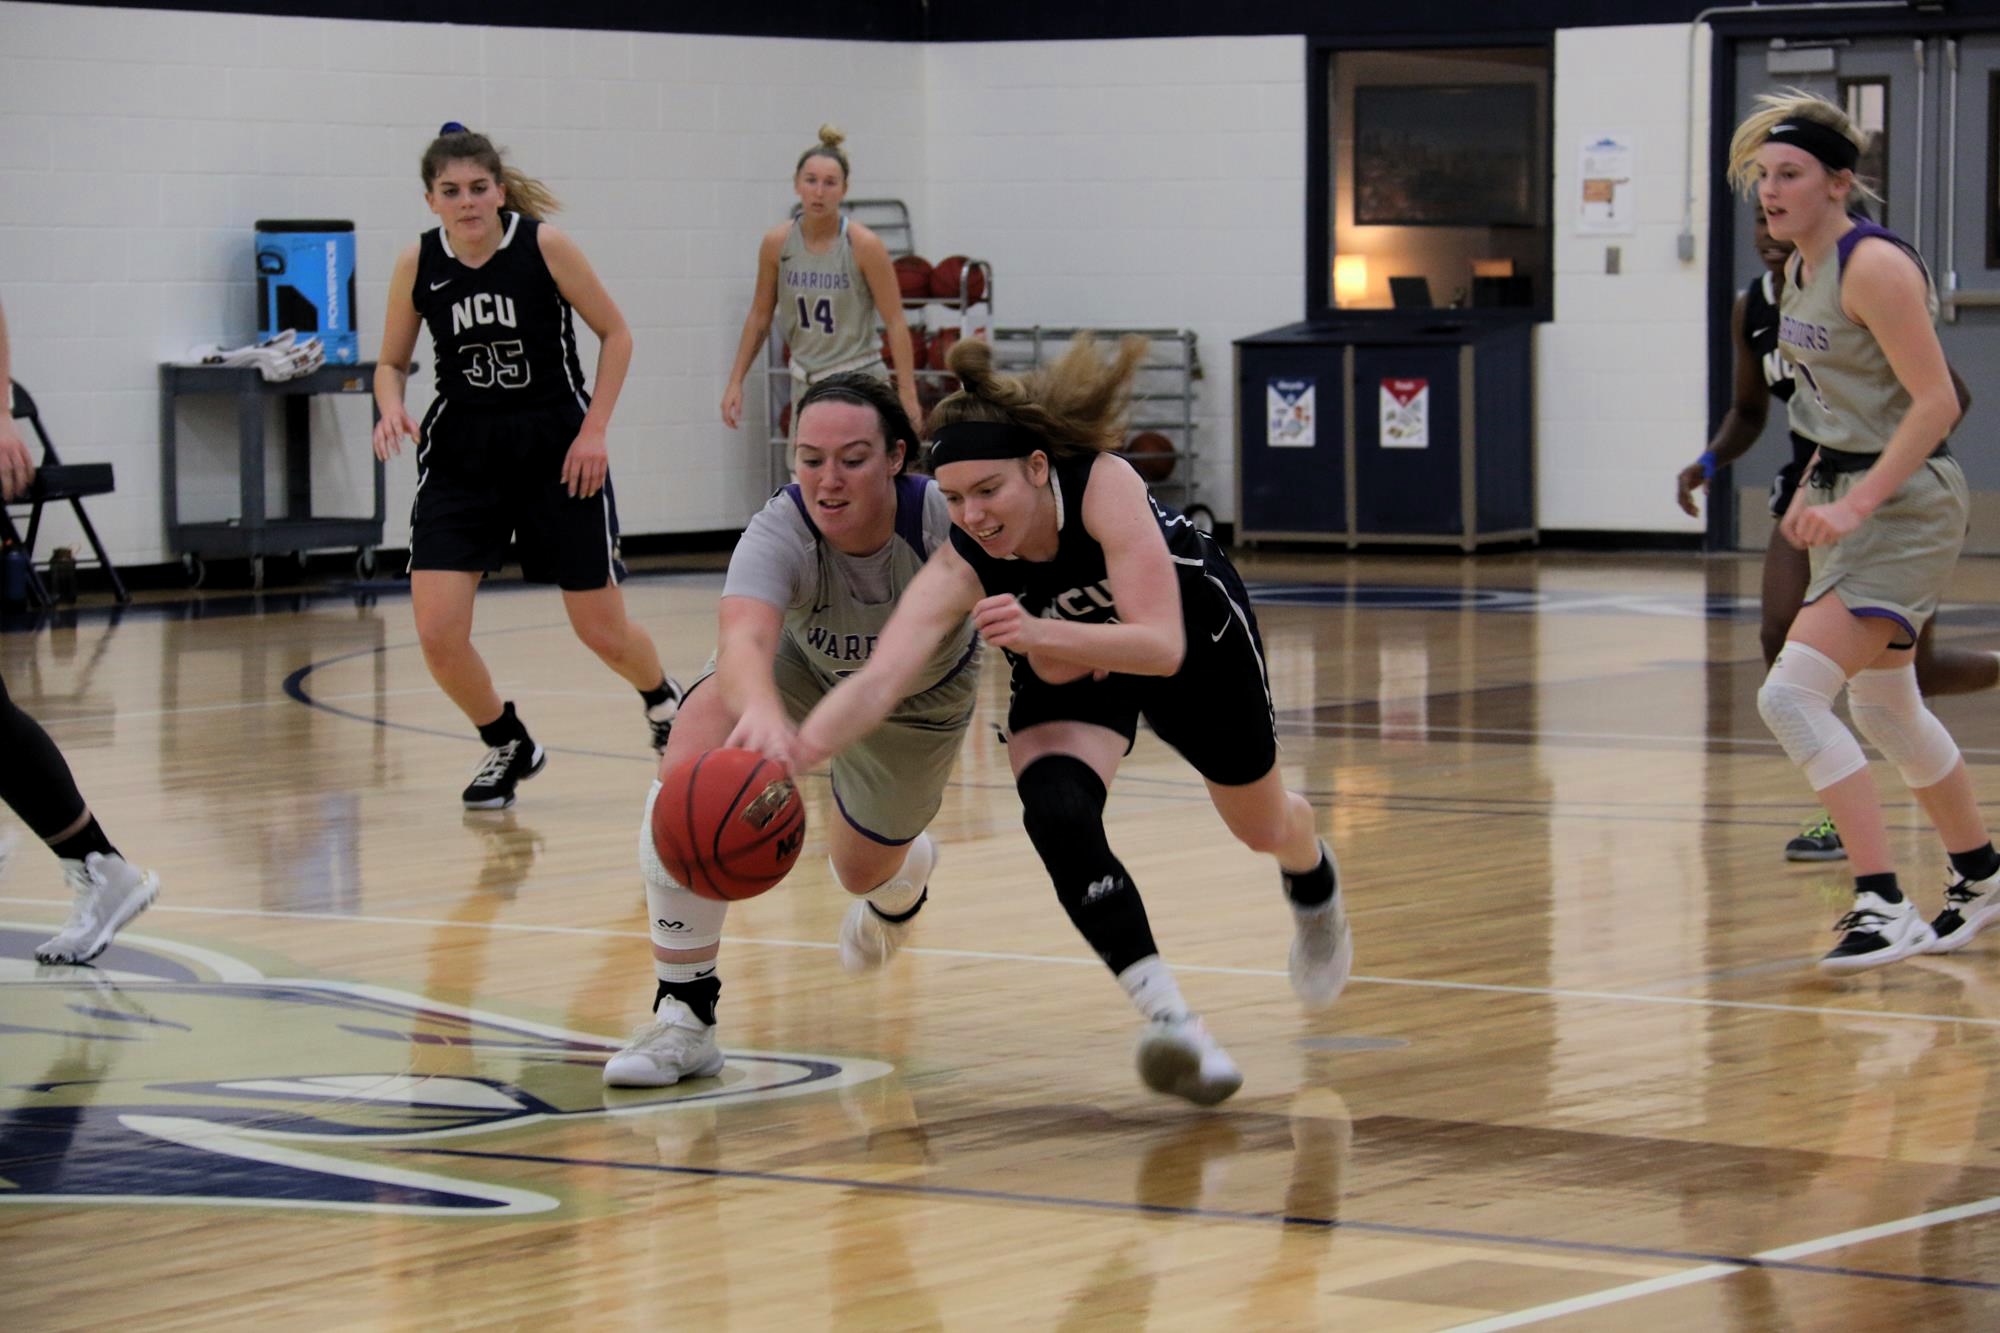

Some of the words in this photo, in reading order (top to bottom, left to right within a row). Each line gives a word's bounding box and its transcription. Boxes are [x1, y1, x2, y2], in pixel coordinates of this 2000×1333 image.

[326, 240, 338, 329] POWERADE
[452, 292, 517, 336] NCU
[796, 295, 834, 335] 14
[458, 339, 532, 389] 35
